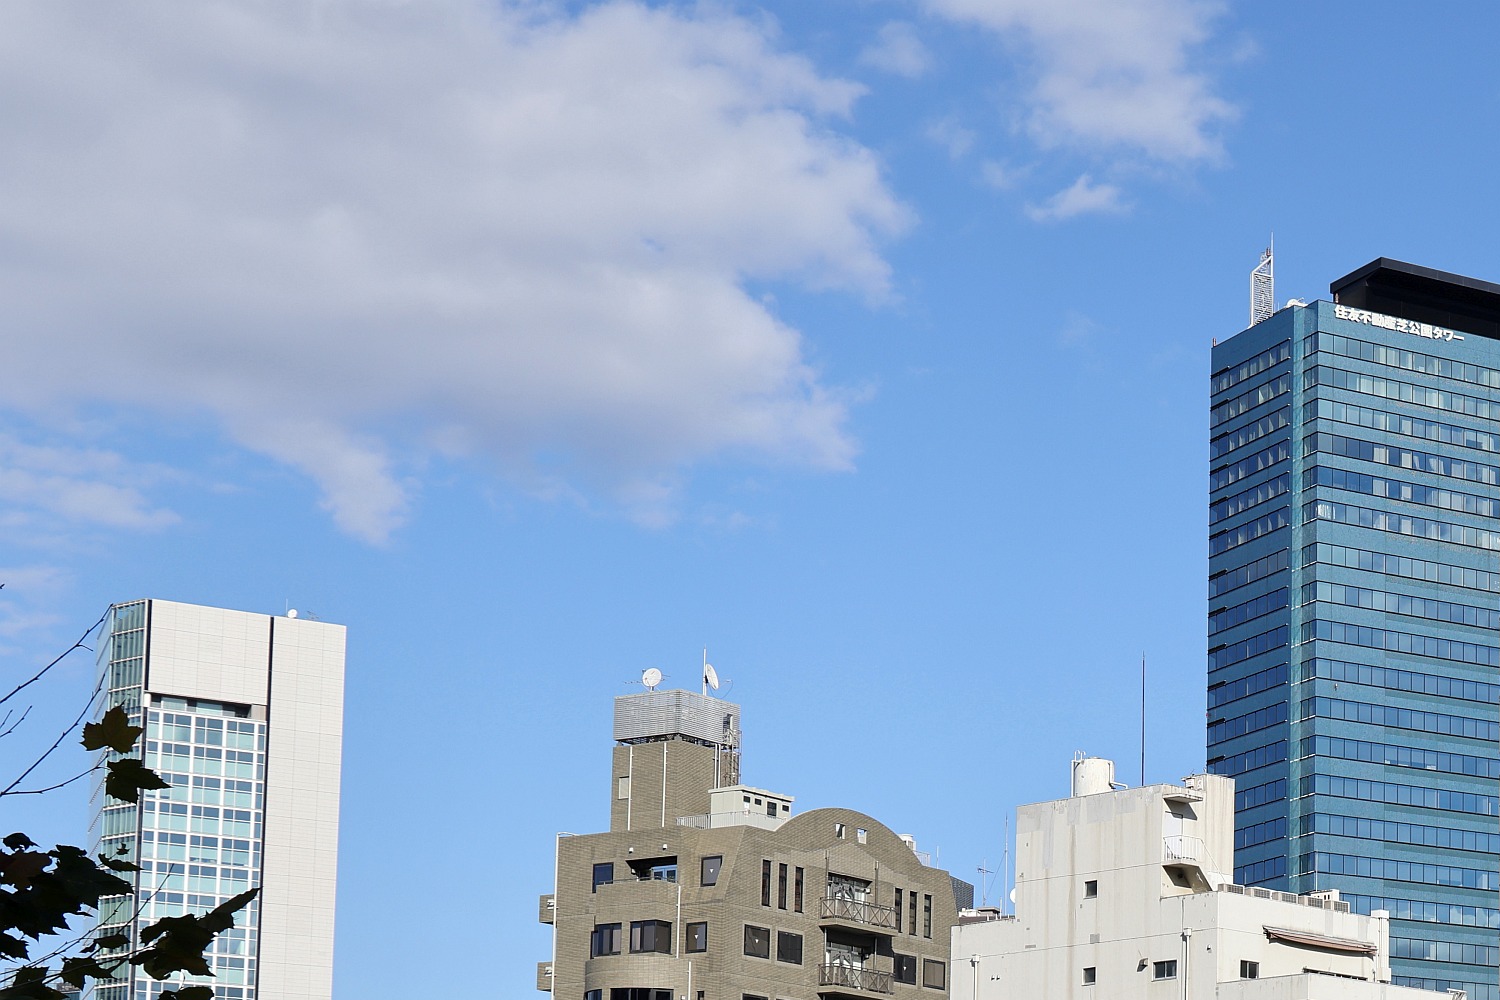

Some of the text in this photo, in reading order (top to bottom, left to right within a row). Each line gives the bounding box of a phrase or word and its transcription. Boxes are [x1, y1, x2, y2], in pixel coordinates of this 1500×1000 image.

[1334, 305, 1465, 342] 住友不動産芝公園タワー
